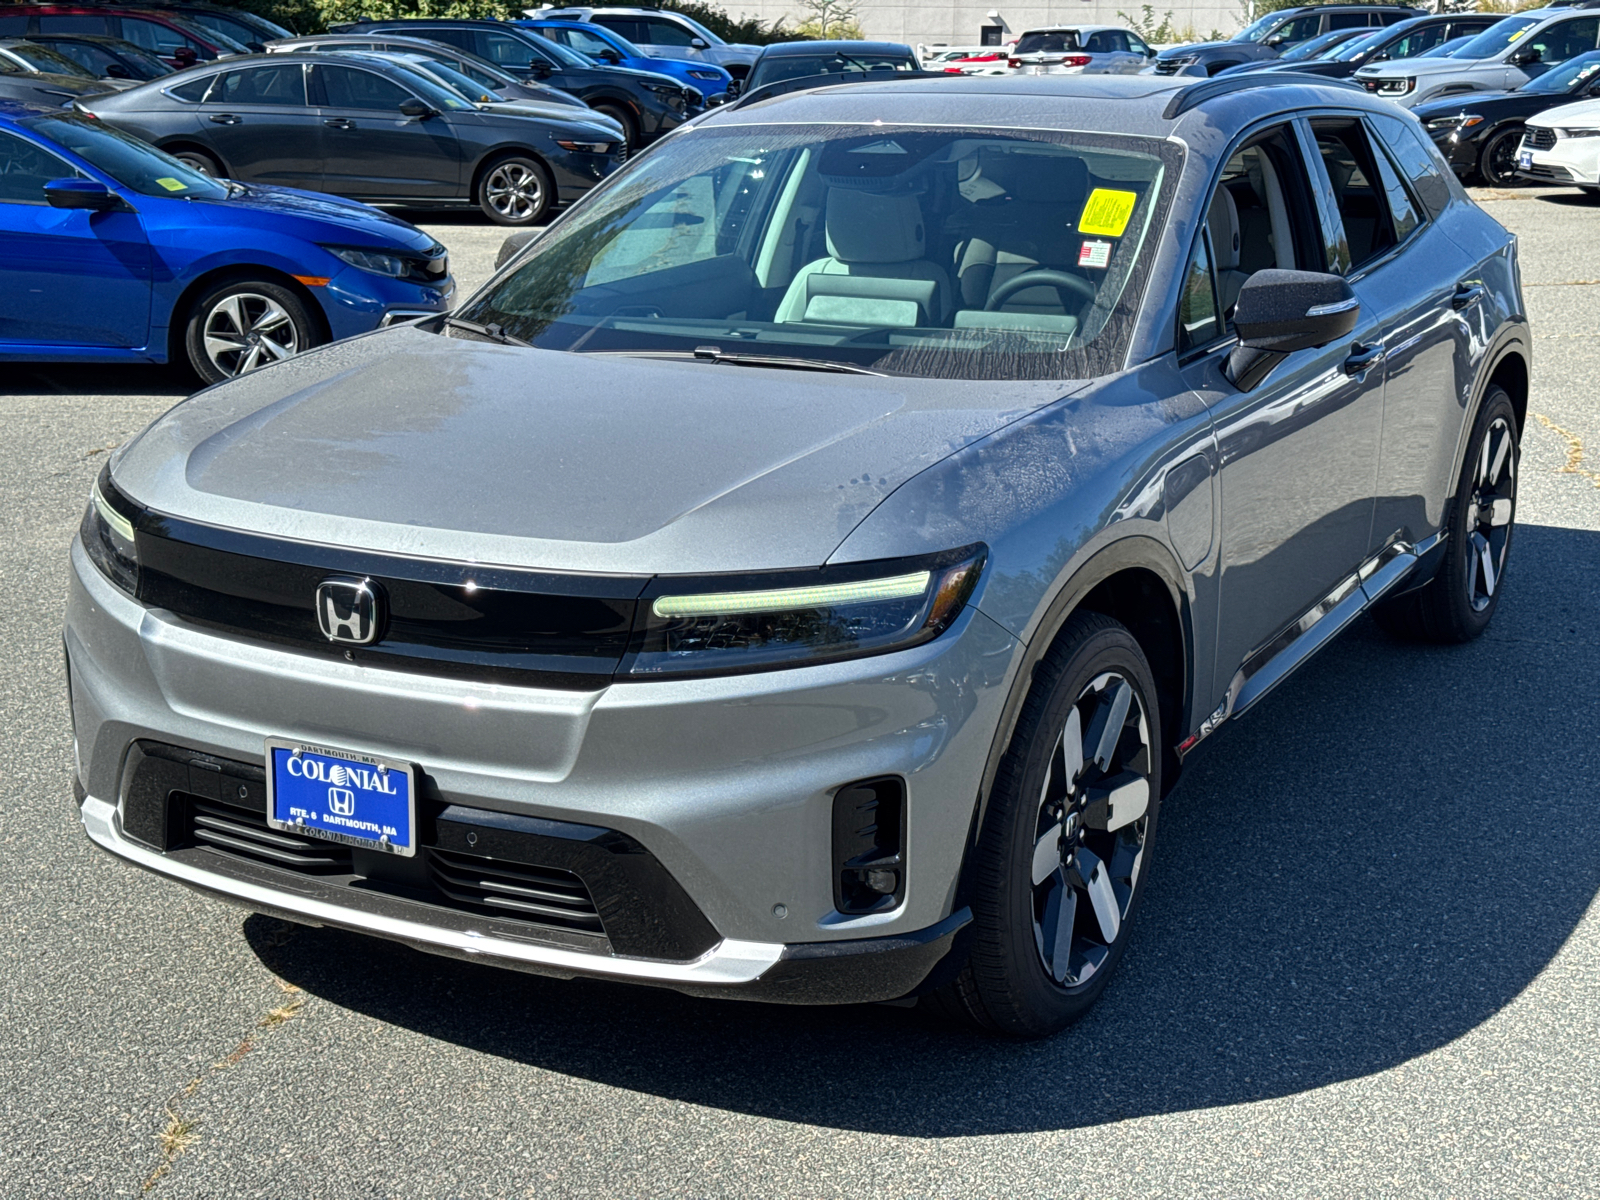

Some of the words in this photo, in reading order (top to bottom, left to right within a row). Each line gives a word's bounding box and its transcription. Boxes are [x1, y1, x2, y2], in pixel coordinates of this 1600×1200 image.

[301, 745, 360, 762] DARTMOUTH,
[362, 756, 377, 764] MA
[286, 756, 397, 795] COLONIAL
[289, 807, 310, 819] RTE.
[311, 811, 317, 820] 6
[323, 813, 381, 834] DARTMOUTH,
[383, 825, 397, 836] MA
